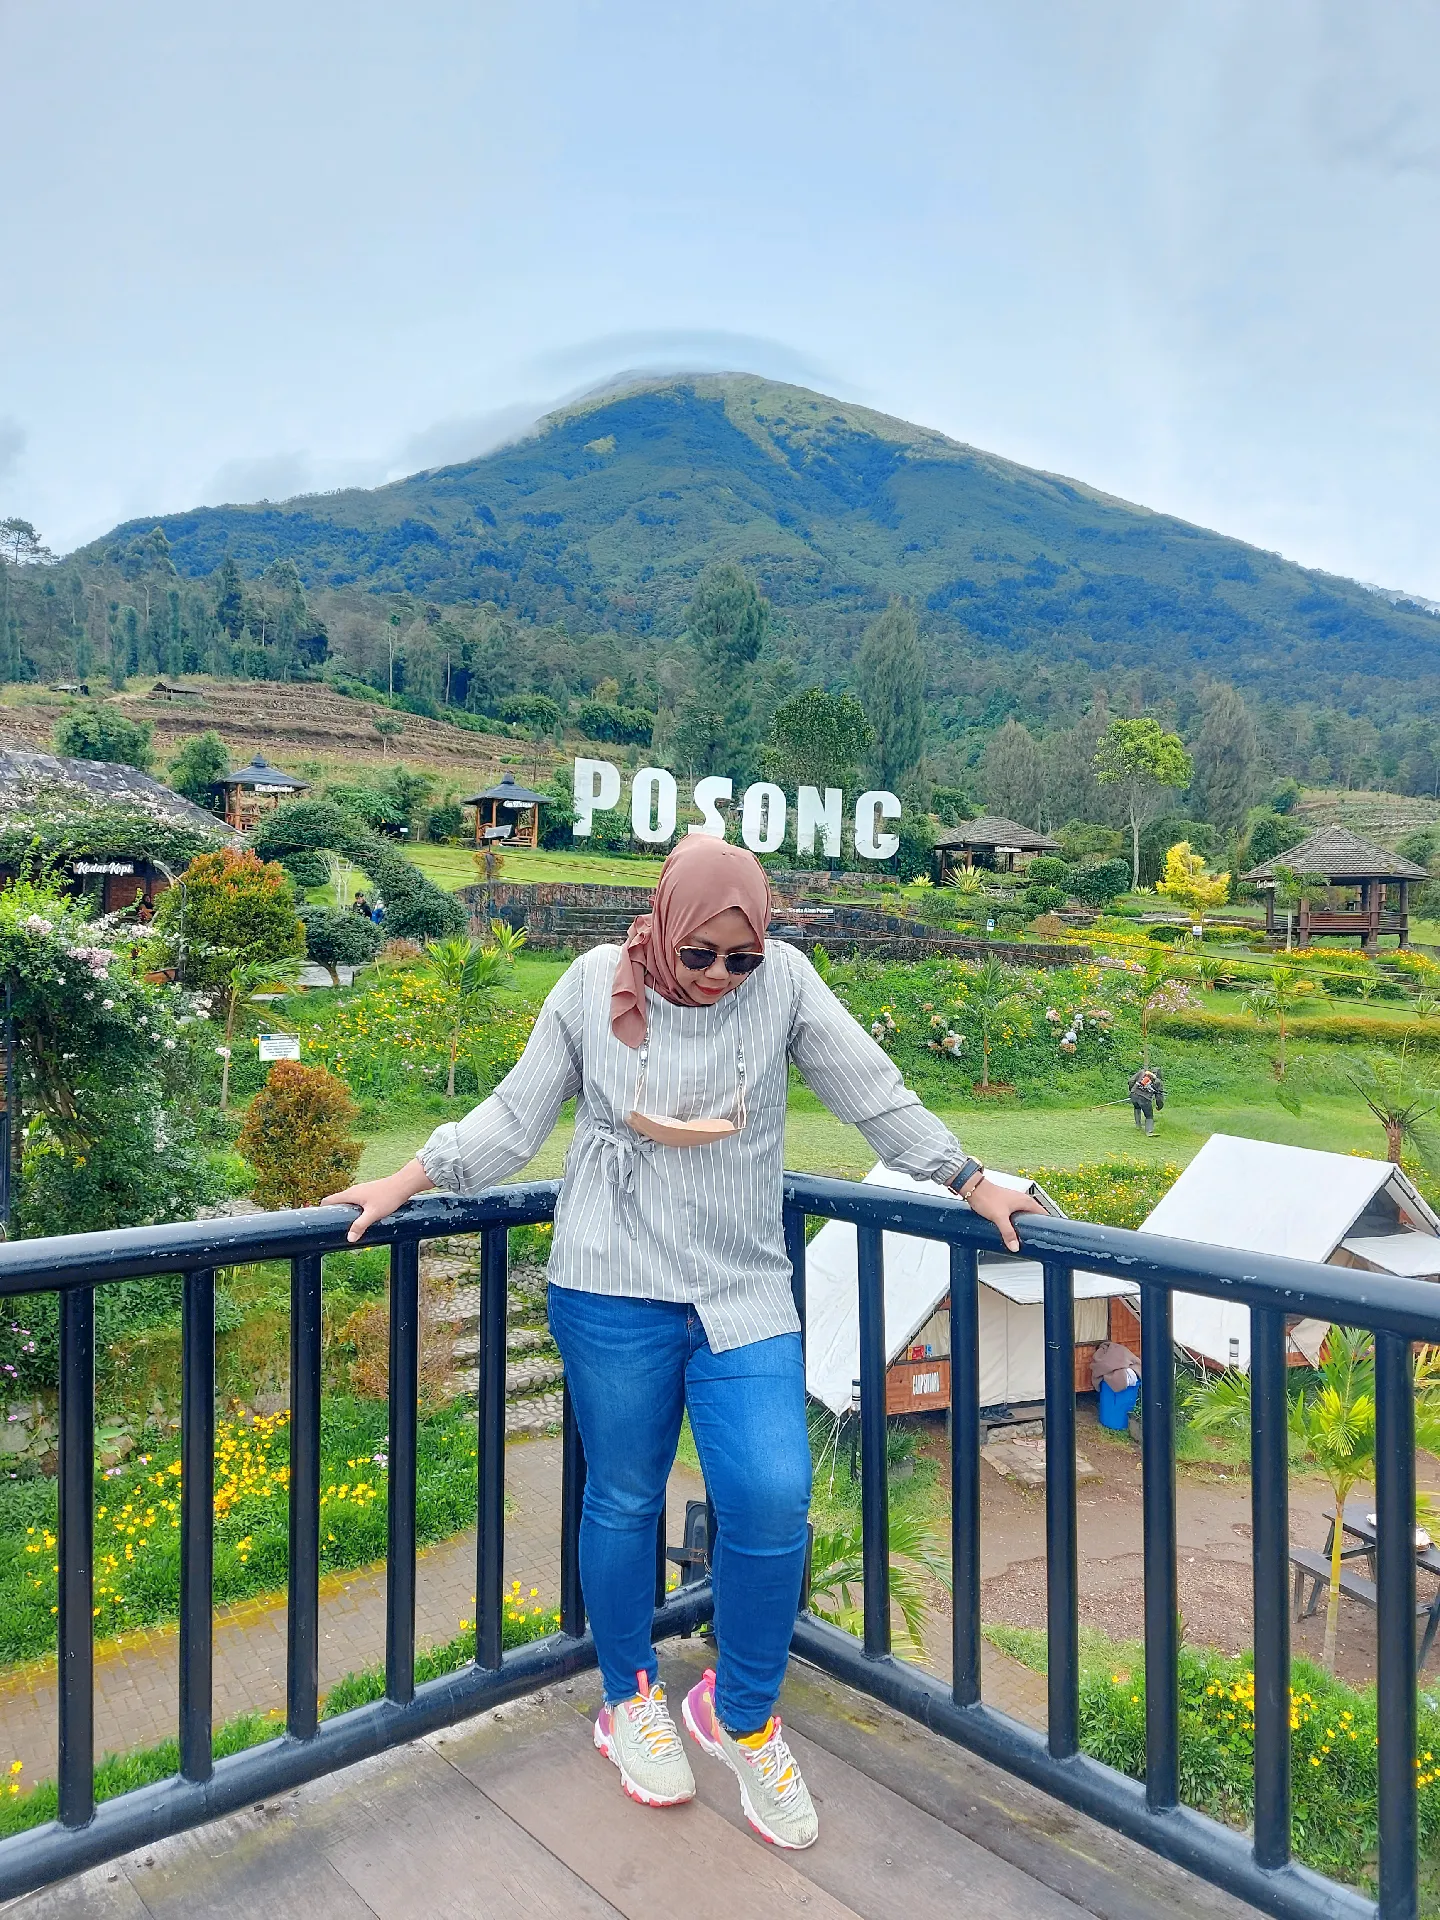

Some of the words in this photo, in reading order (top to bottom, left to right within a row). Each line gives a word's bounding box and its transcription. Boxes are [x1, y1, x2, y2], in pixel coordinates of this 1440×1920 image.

[573, 757, 901, 860] POSONG
[77, 862, 107, 874] Kedai
[109, 862, 131, 876] Kopi
